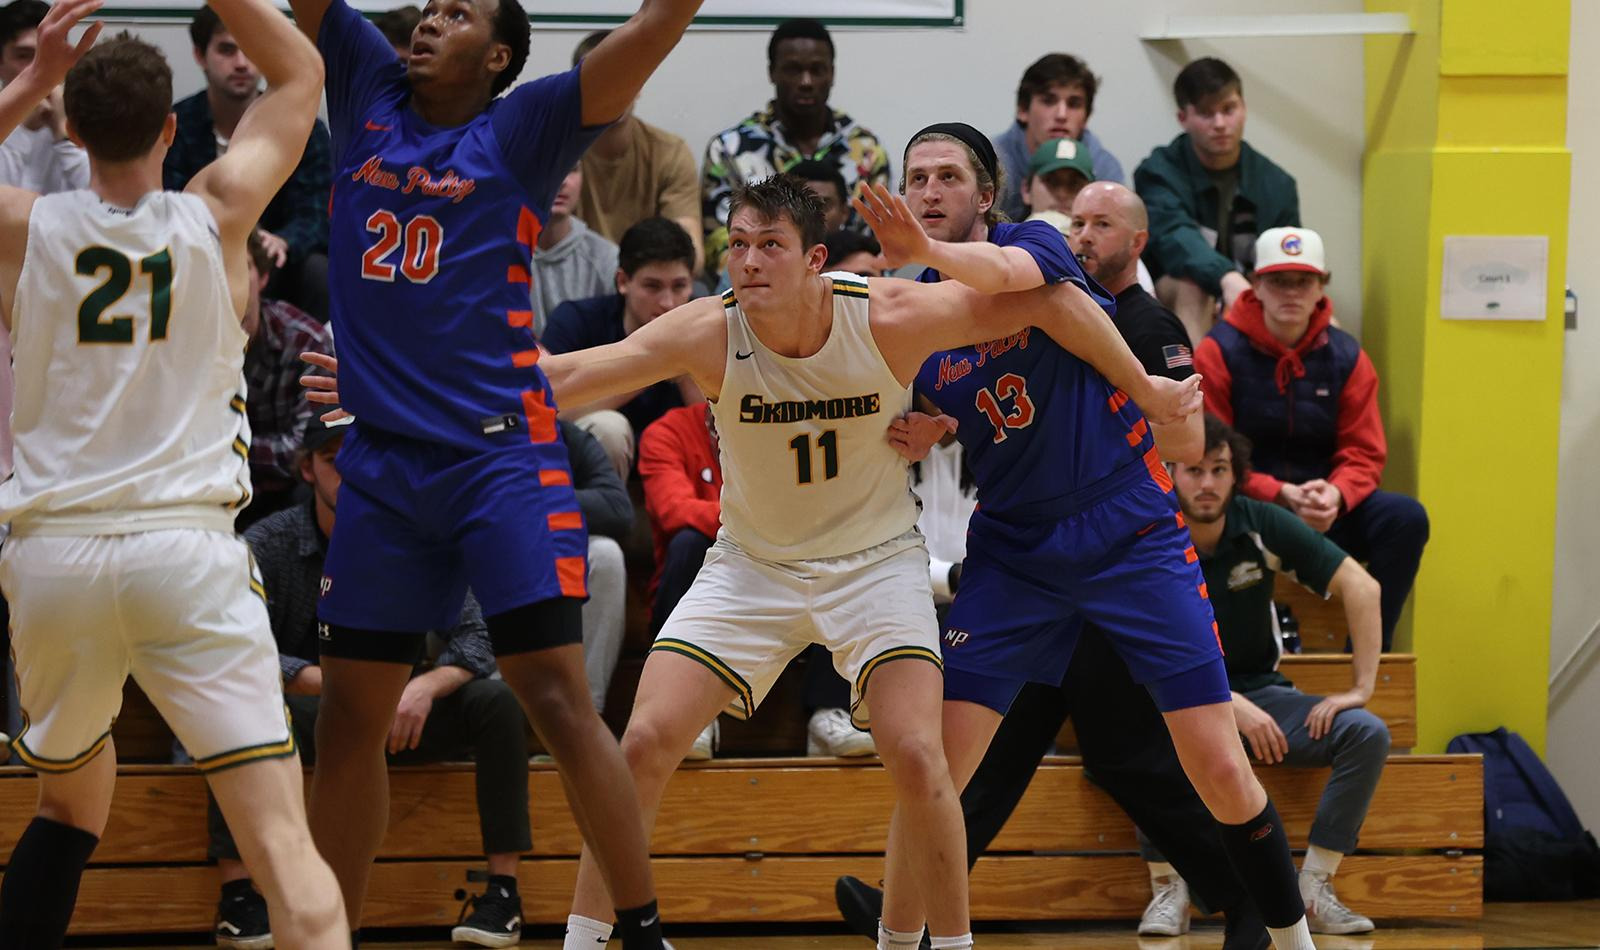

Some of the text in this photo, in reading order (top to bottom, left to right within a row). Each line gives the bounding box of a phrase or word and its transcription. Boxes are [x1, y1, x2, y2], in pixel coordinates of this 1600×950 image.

[352, 154, 476, 204] New Paltz
[361, 208, 444, 285] 20
[75, 244, 173, 346] 21
[934, 354, 972, 391] New
[739, 392, 881, 424] SKIDMORE
[975, 372, 1036, 444] 13
[788, 428, 840, 486] 11
[944, 629, 969, 647] NP
